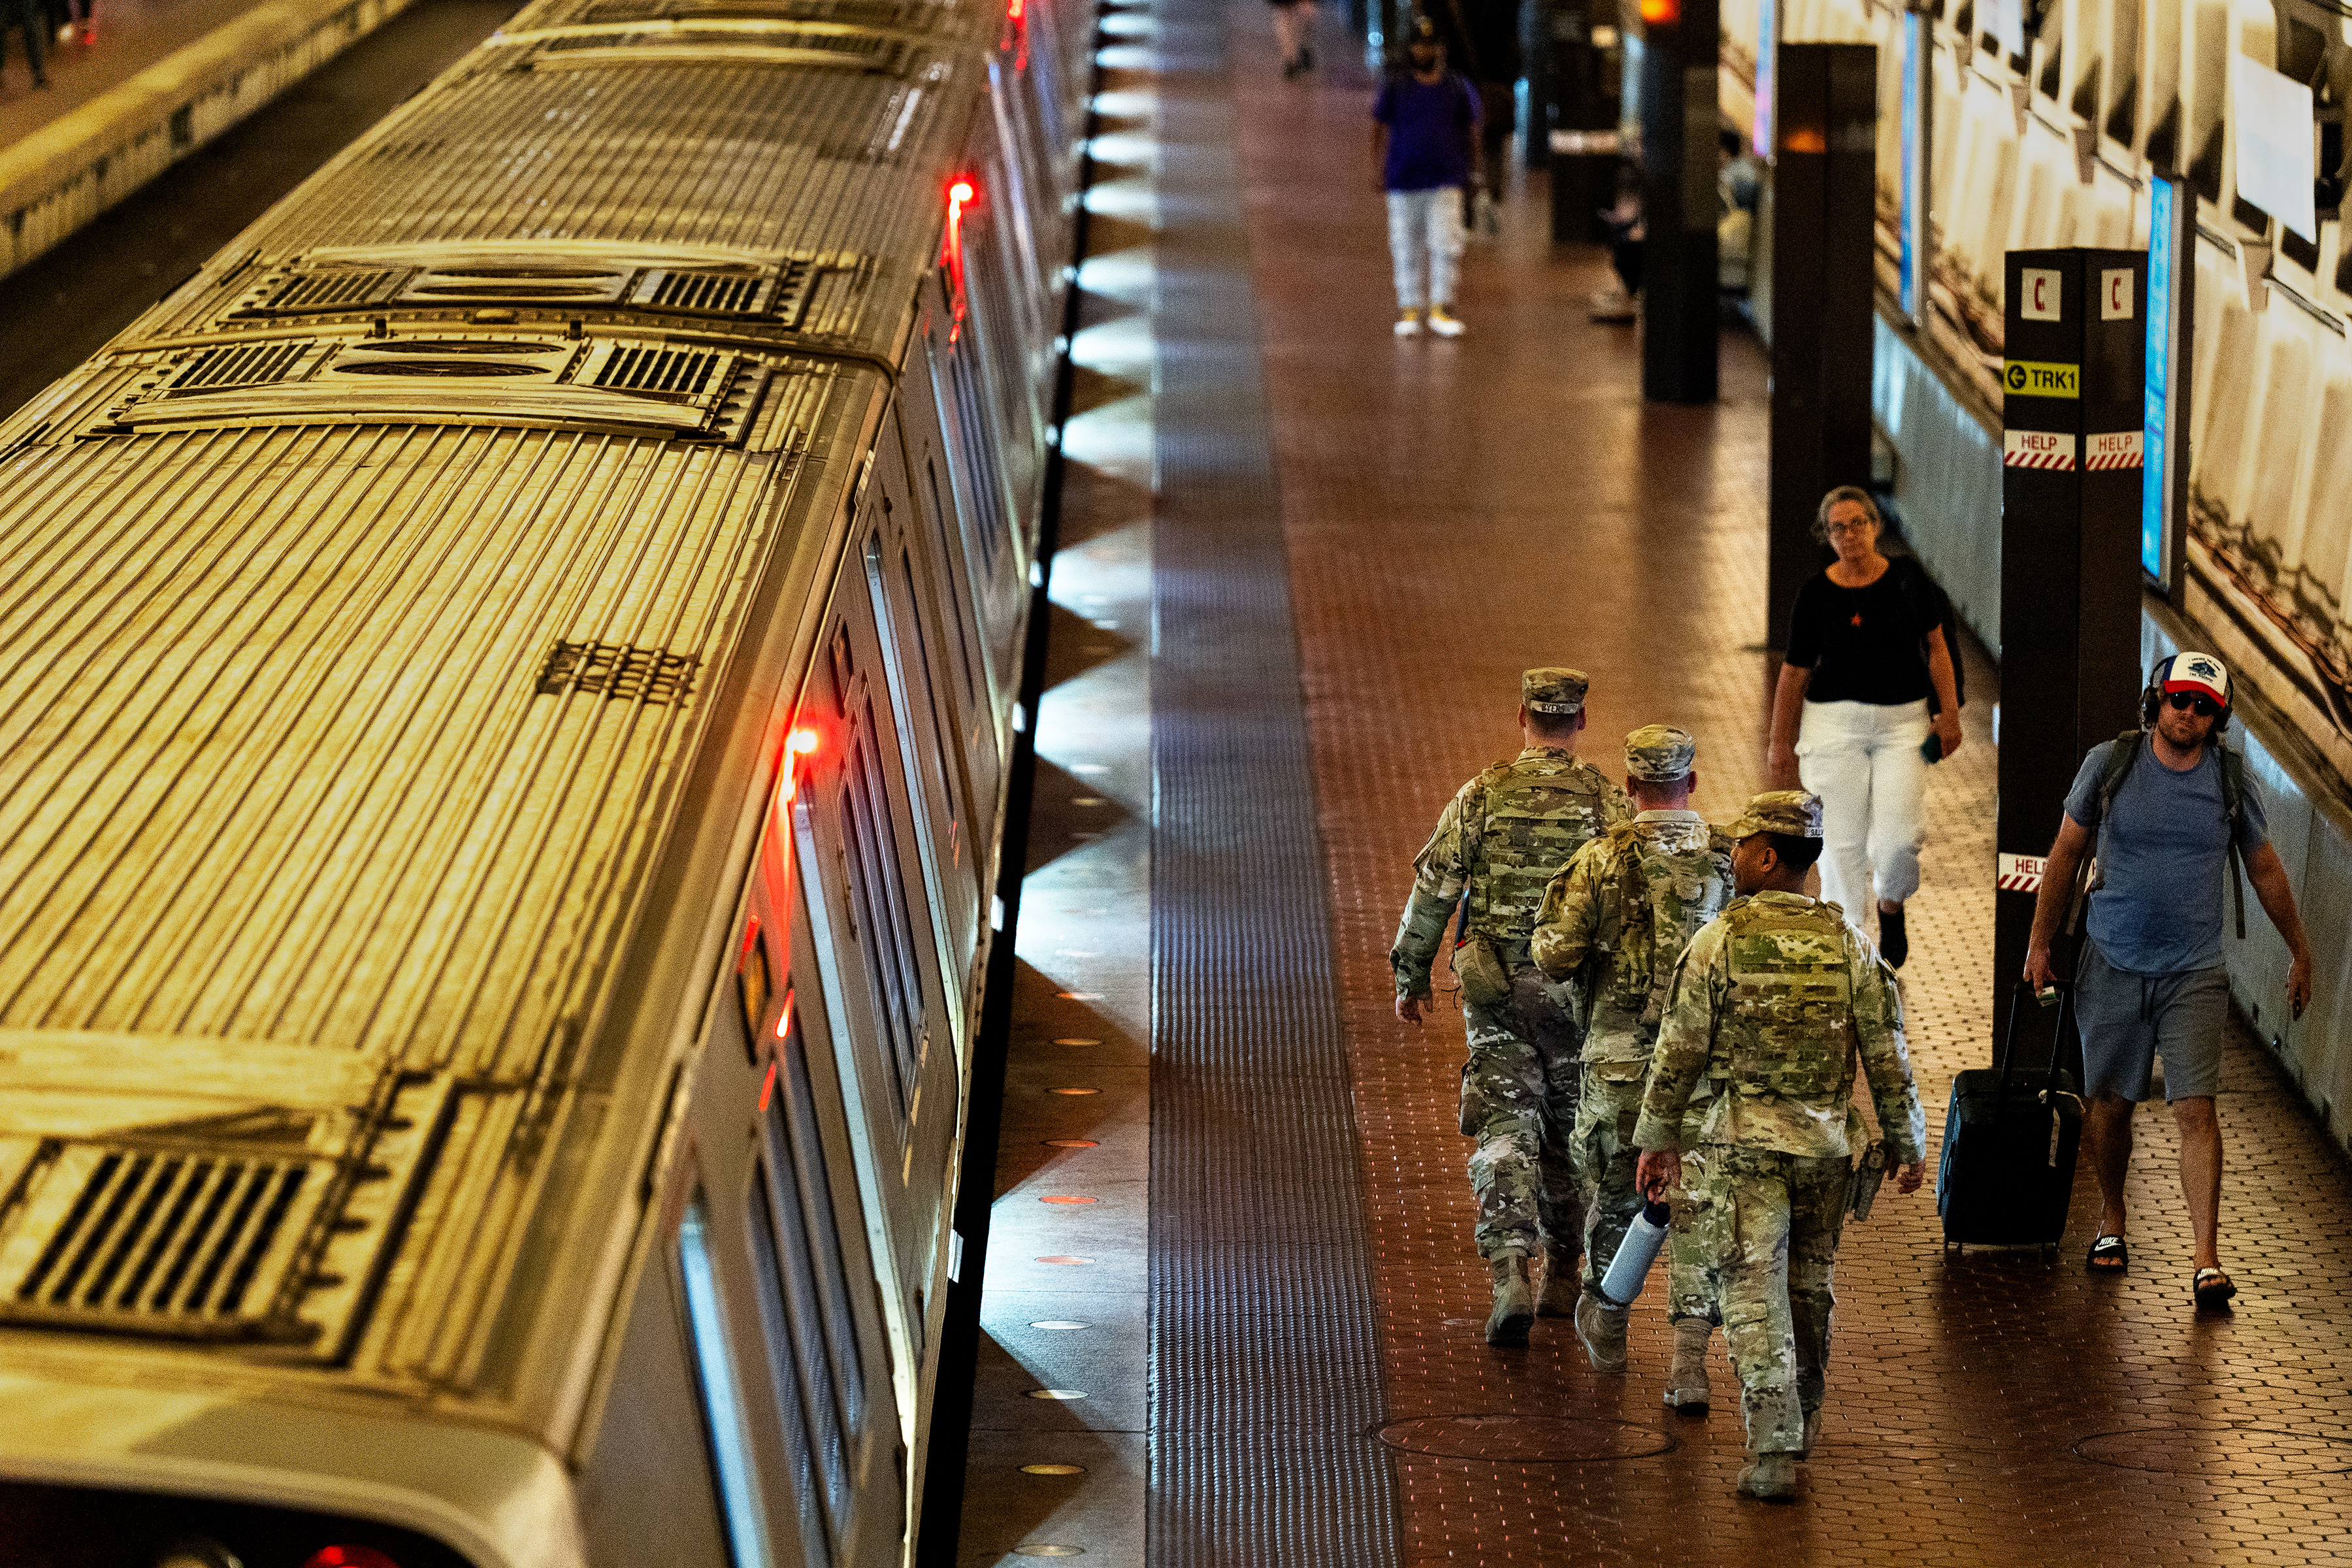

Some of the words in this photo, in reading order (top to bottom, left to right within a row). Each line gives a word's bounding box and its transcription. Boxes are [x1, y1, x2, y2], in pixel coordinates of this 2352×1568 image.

[2033, 369, 2075, 389] TRK1
[2021, 435, 2057, 451] HELP
[2099, 435, 2132, 451] HELP
[1542, 703, 1565, 713] BYERS
[2099, 1236, 2119, 1245] NIKE
